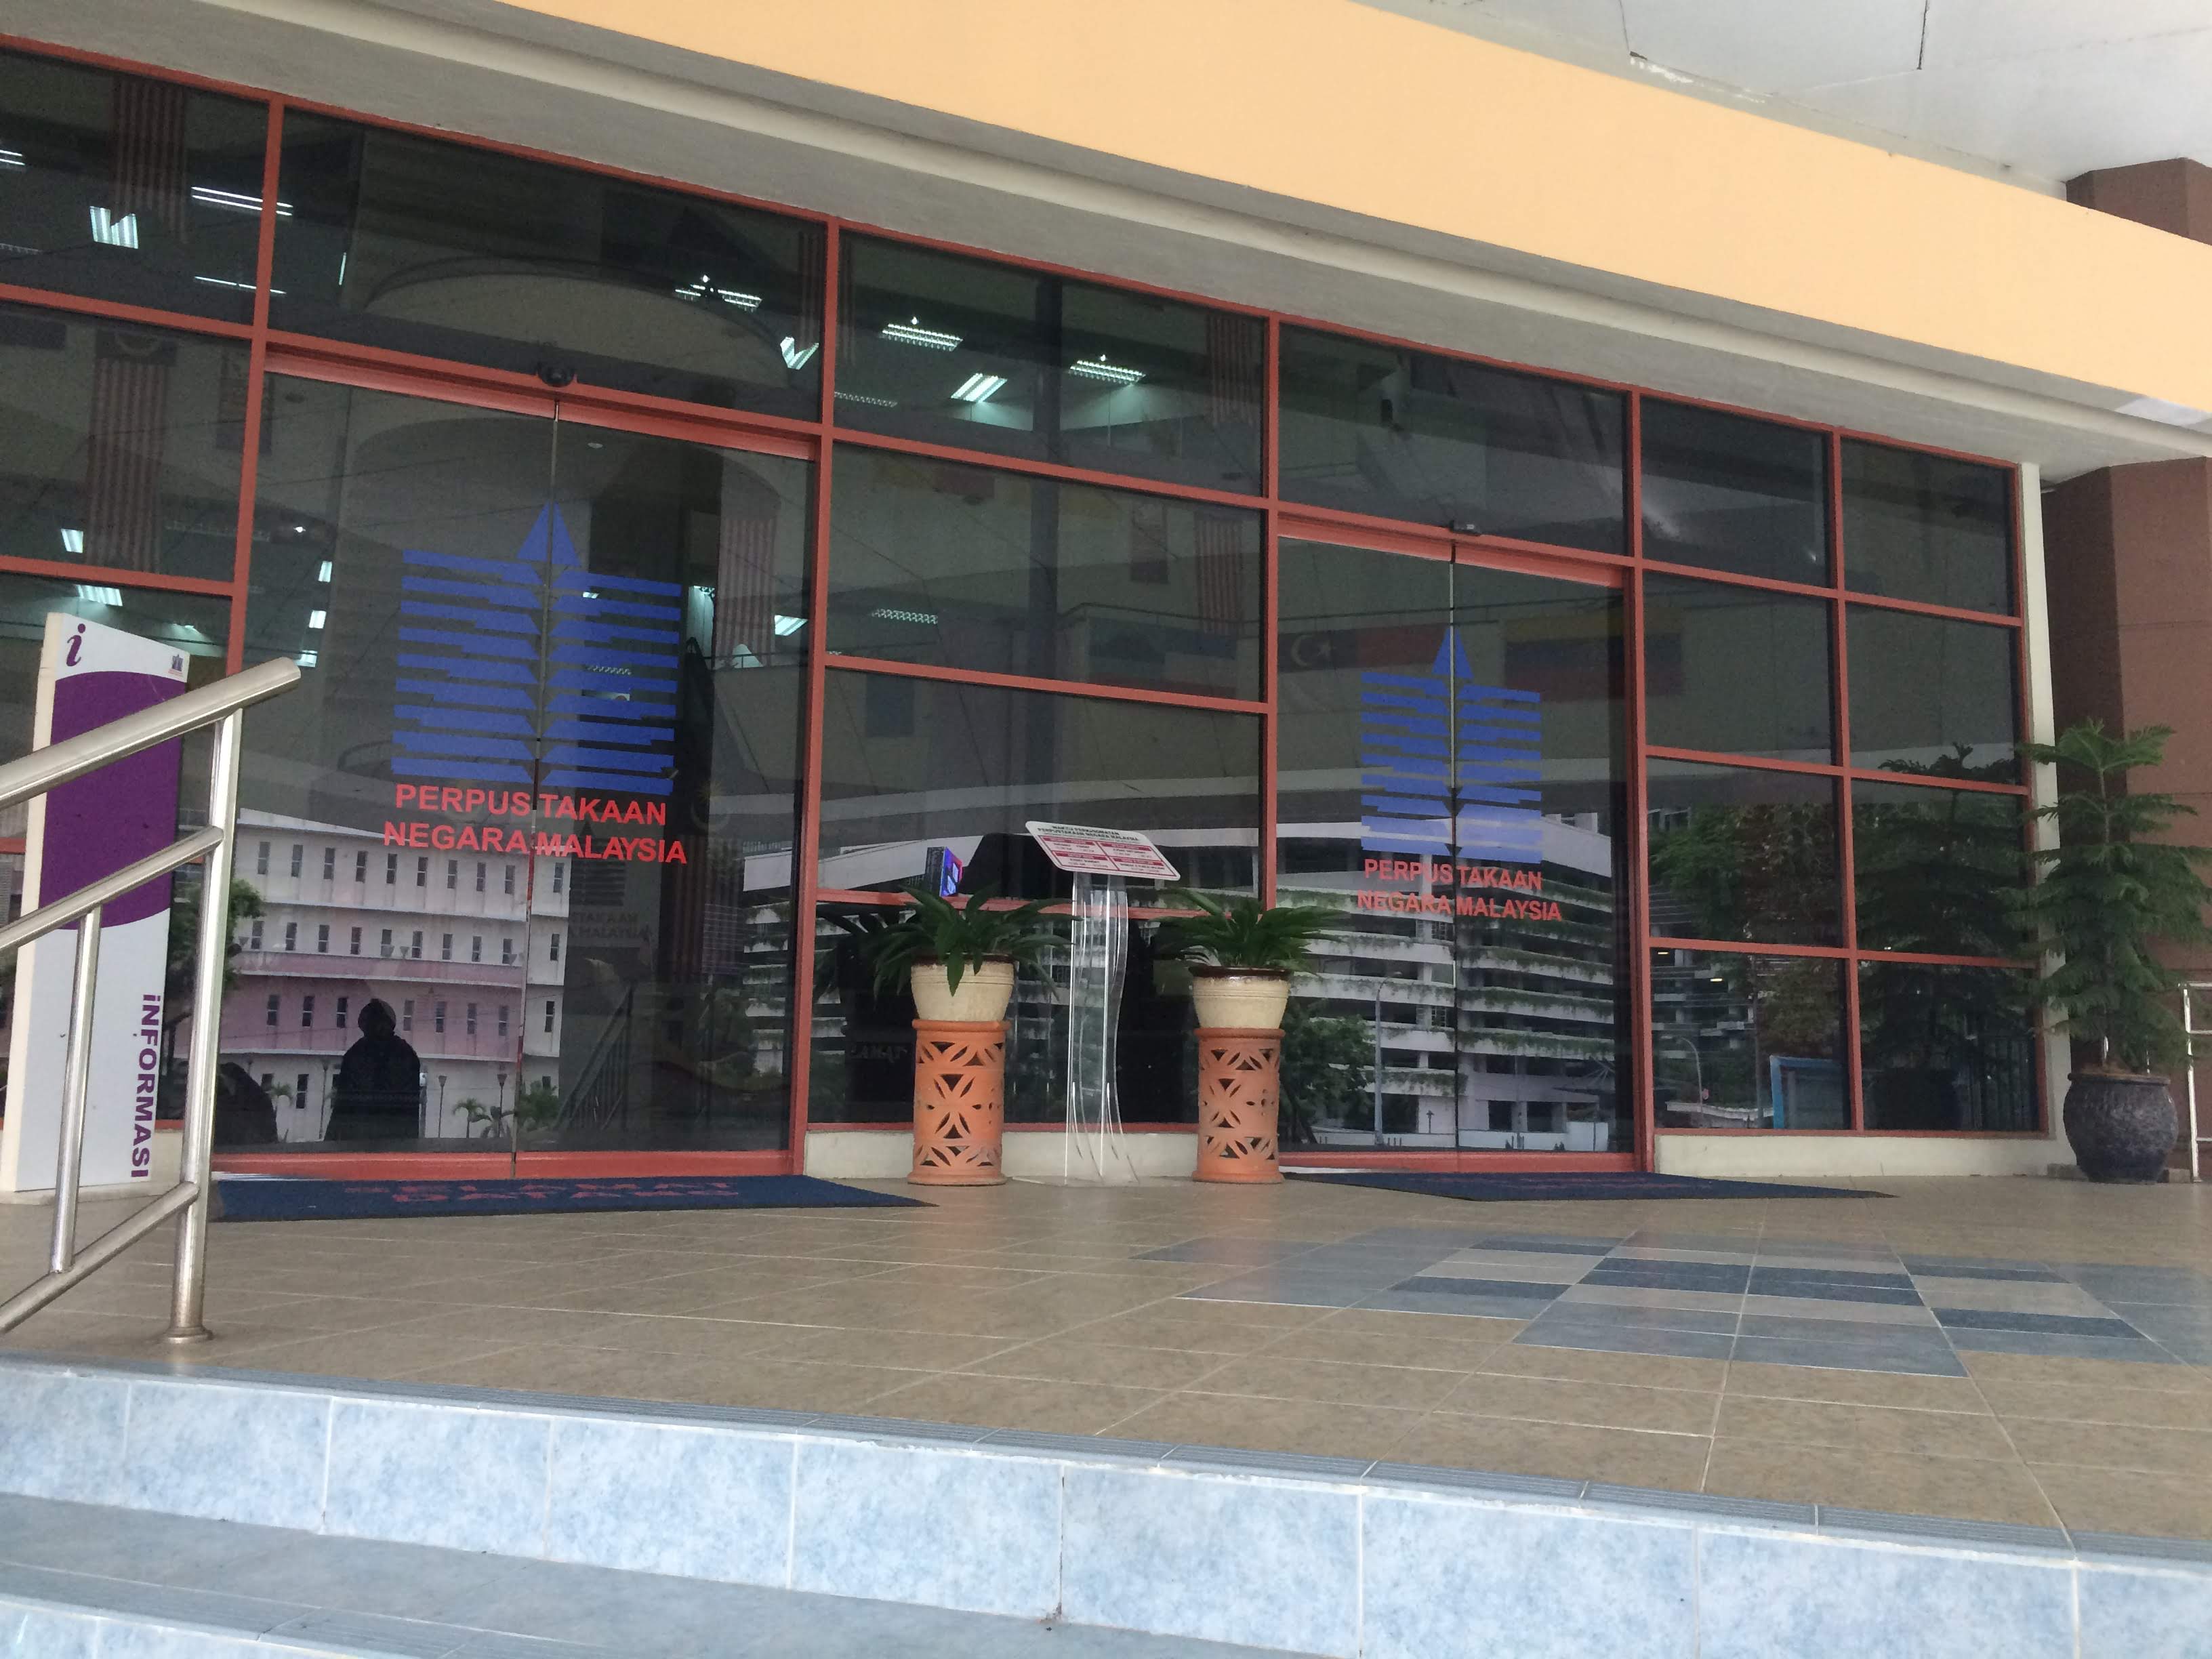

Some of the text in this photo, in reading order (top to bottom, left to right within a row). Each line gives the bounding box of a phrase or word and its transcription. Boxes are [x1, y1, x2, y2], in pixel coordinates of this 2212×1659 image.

[383, 821, 687, 865] NEGARA MALAYSIA
[1357, 889, 1562, 922] NEGARA MALAYSIA
